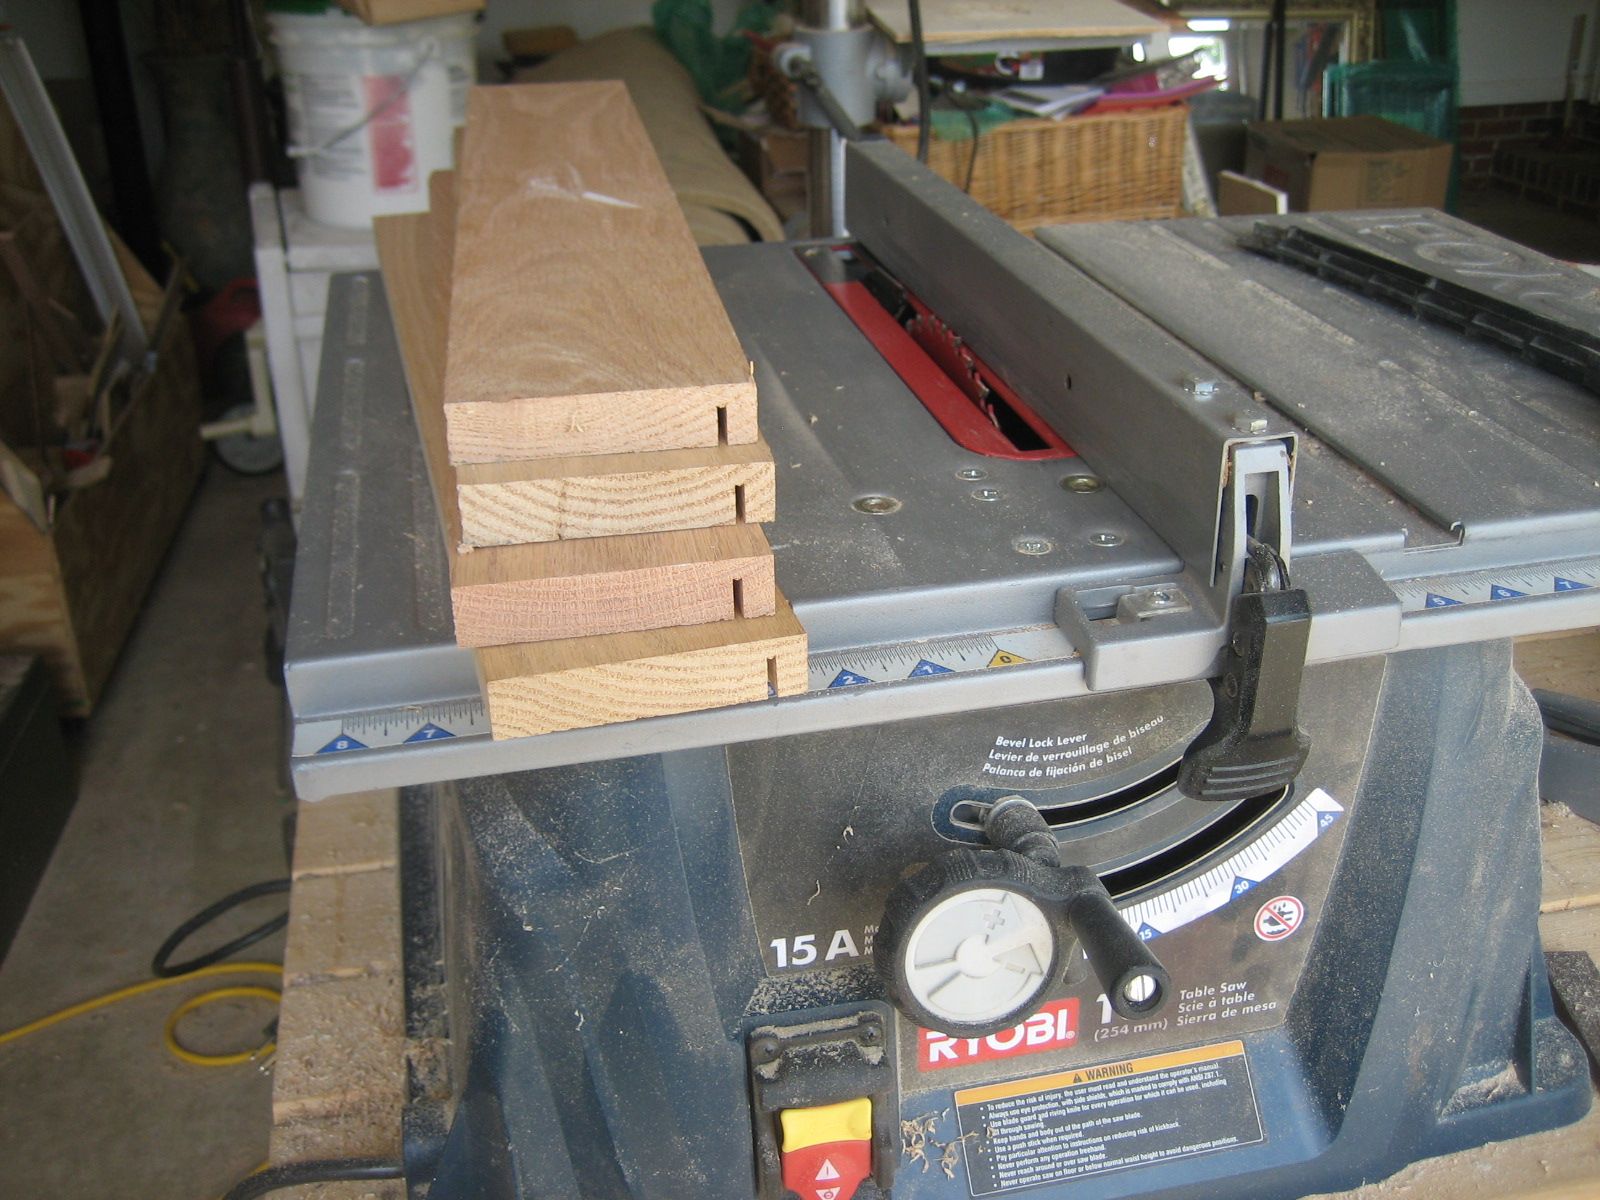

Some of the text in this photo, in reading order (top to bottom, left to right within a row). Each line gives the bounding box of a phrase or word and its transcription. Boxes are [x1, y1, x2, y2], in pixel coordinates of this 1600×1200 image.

[1433, 598, 1445, 606] 5
[336, 740, 348, 749] 8
[423, 729, 436, 738] 7
[842, 675, 856, 684] 2
[988, 716, 1164, 762] Levier de verrouillage de biseau
[995, 733, 1087, 748] Bevel Lock Lever
[982, 746, 1133, 778] Palanca de fijación de bisel
[1320, 814, 1334, 828] 45
[1234, 881, 1250, 894] 30
[1139, 928, 1153, 940] 15
[770, 929, 860, 968] 15 A
[1179, 980, 1248, 1000] Table Saw
[1178, 991, 1255, 1014] Scie à table
[1176, 1002, 1277, 1026] Sierra de mesa
[1094, 1018, 1168, 1042] (254 mm)
[1085, 1062, 1133, 1080] WARNING
